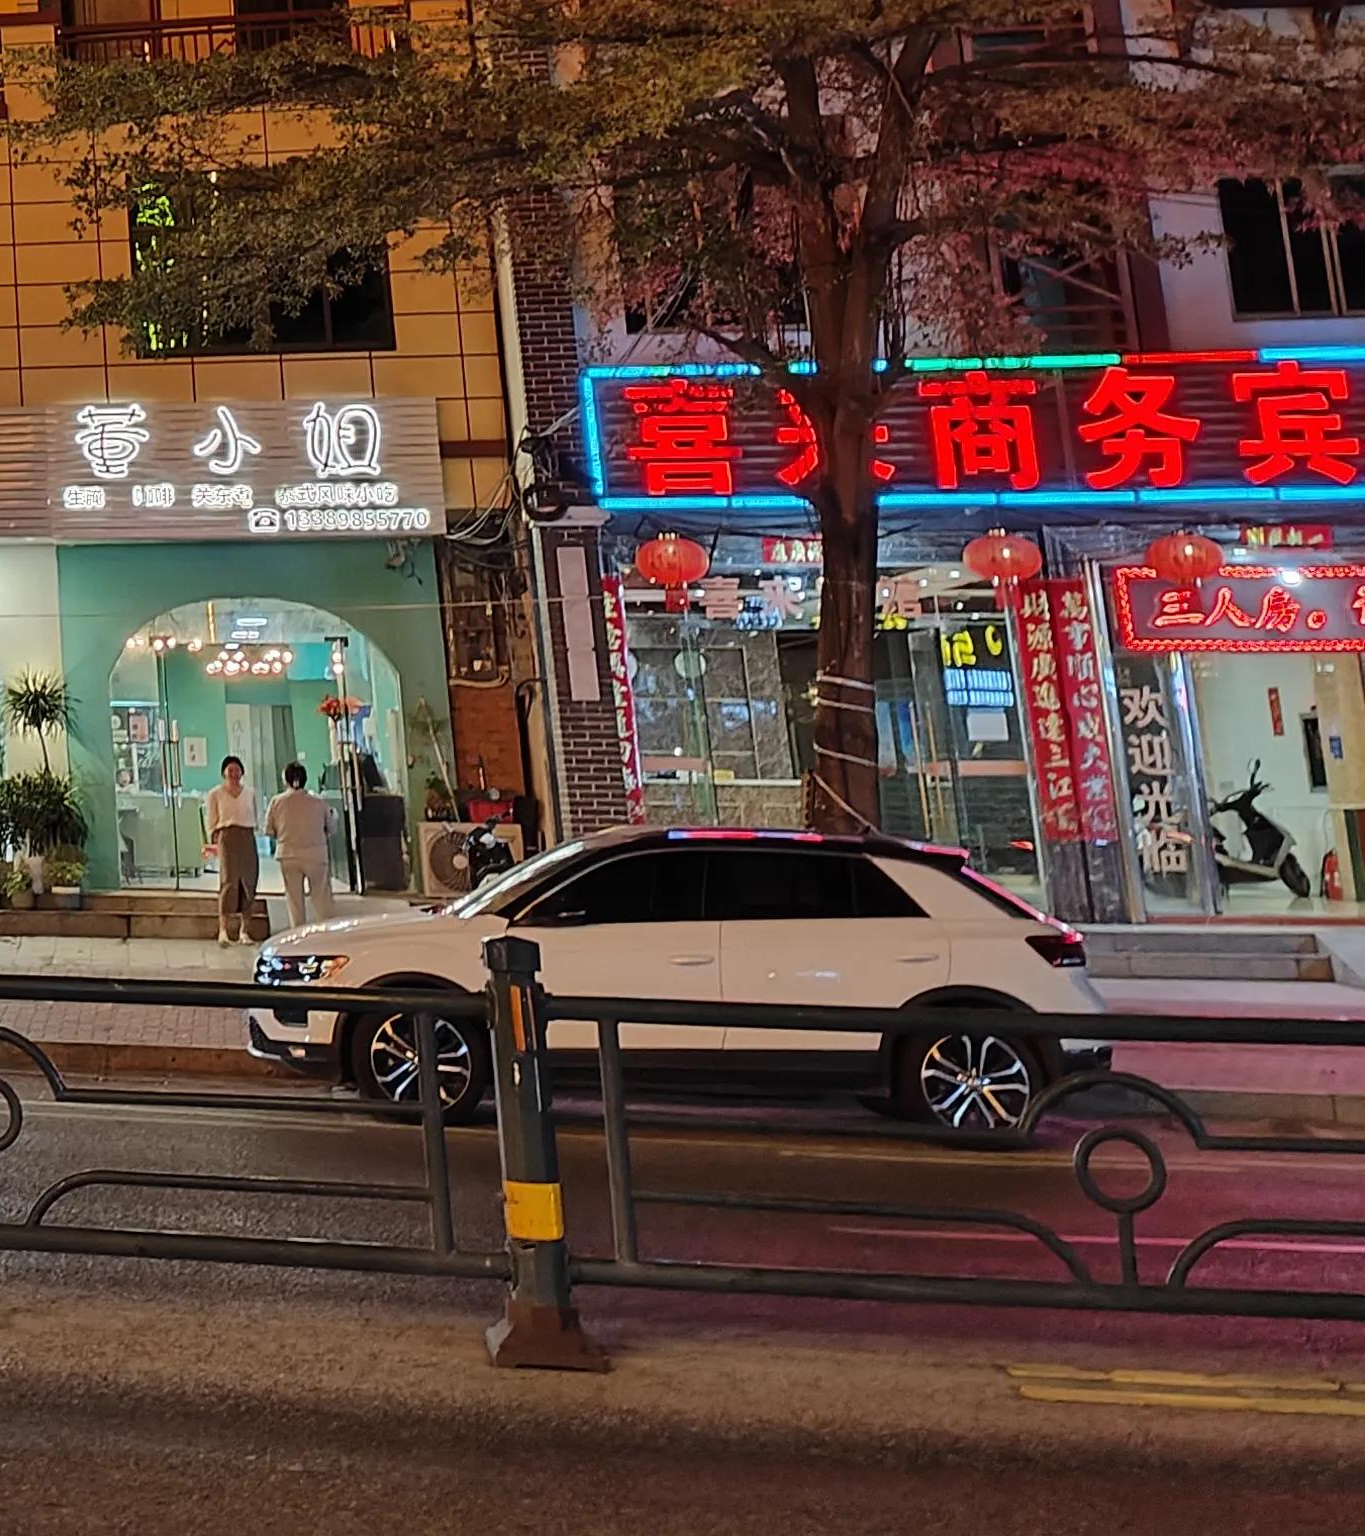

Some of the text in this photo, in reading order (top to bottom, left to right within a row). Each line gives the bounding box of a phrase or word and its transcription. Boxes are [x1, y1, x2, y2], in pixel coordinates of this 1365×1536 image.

[75, 403, 381, 478] 董小姐
[1119, 684, 1190, 879] 欢迎光临
